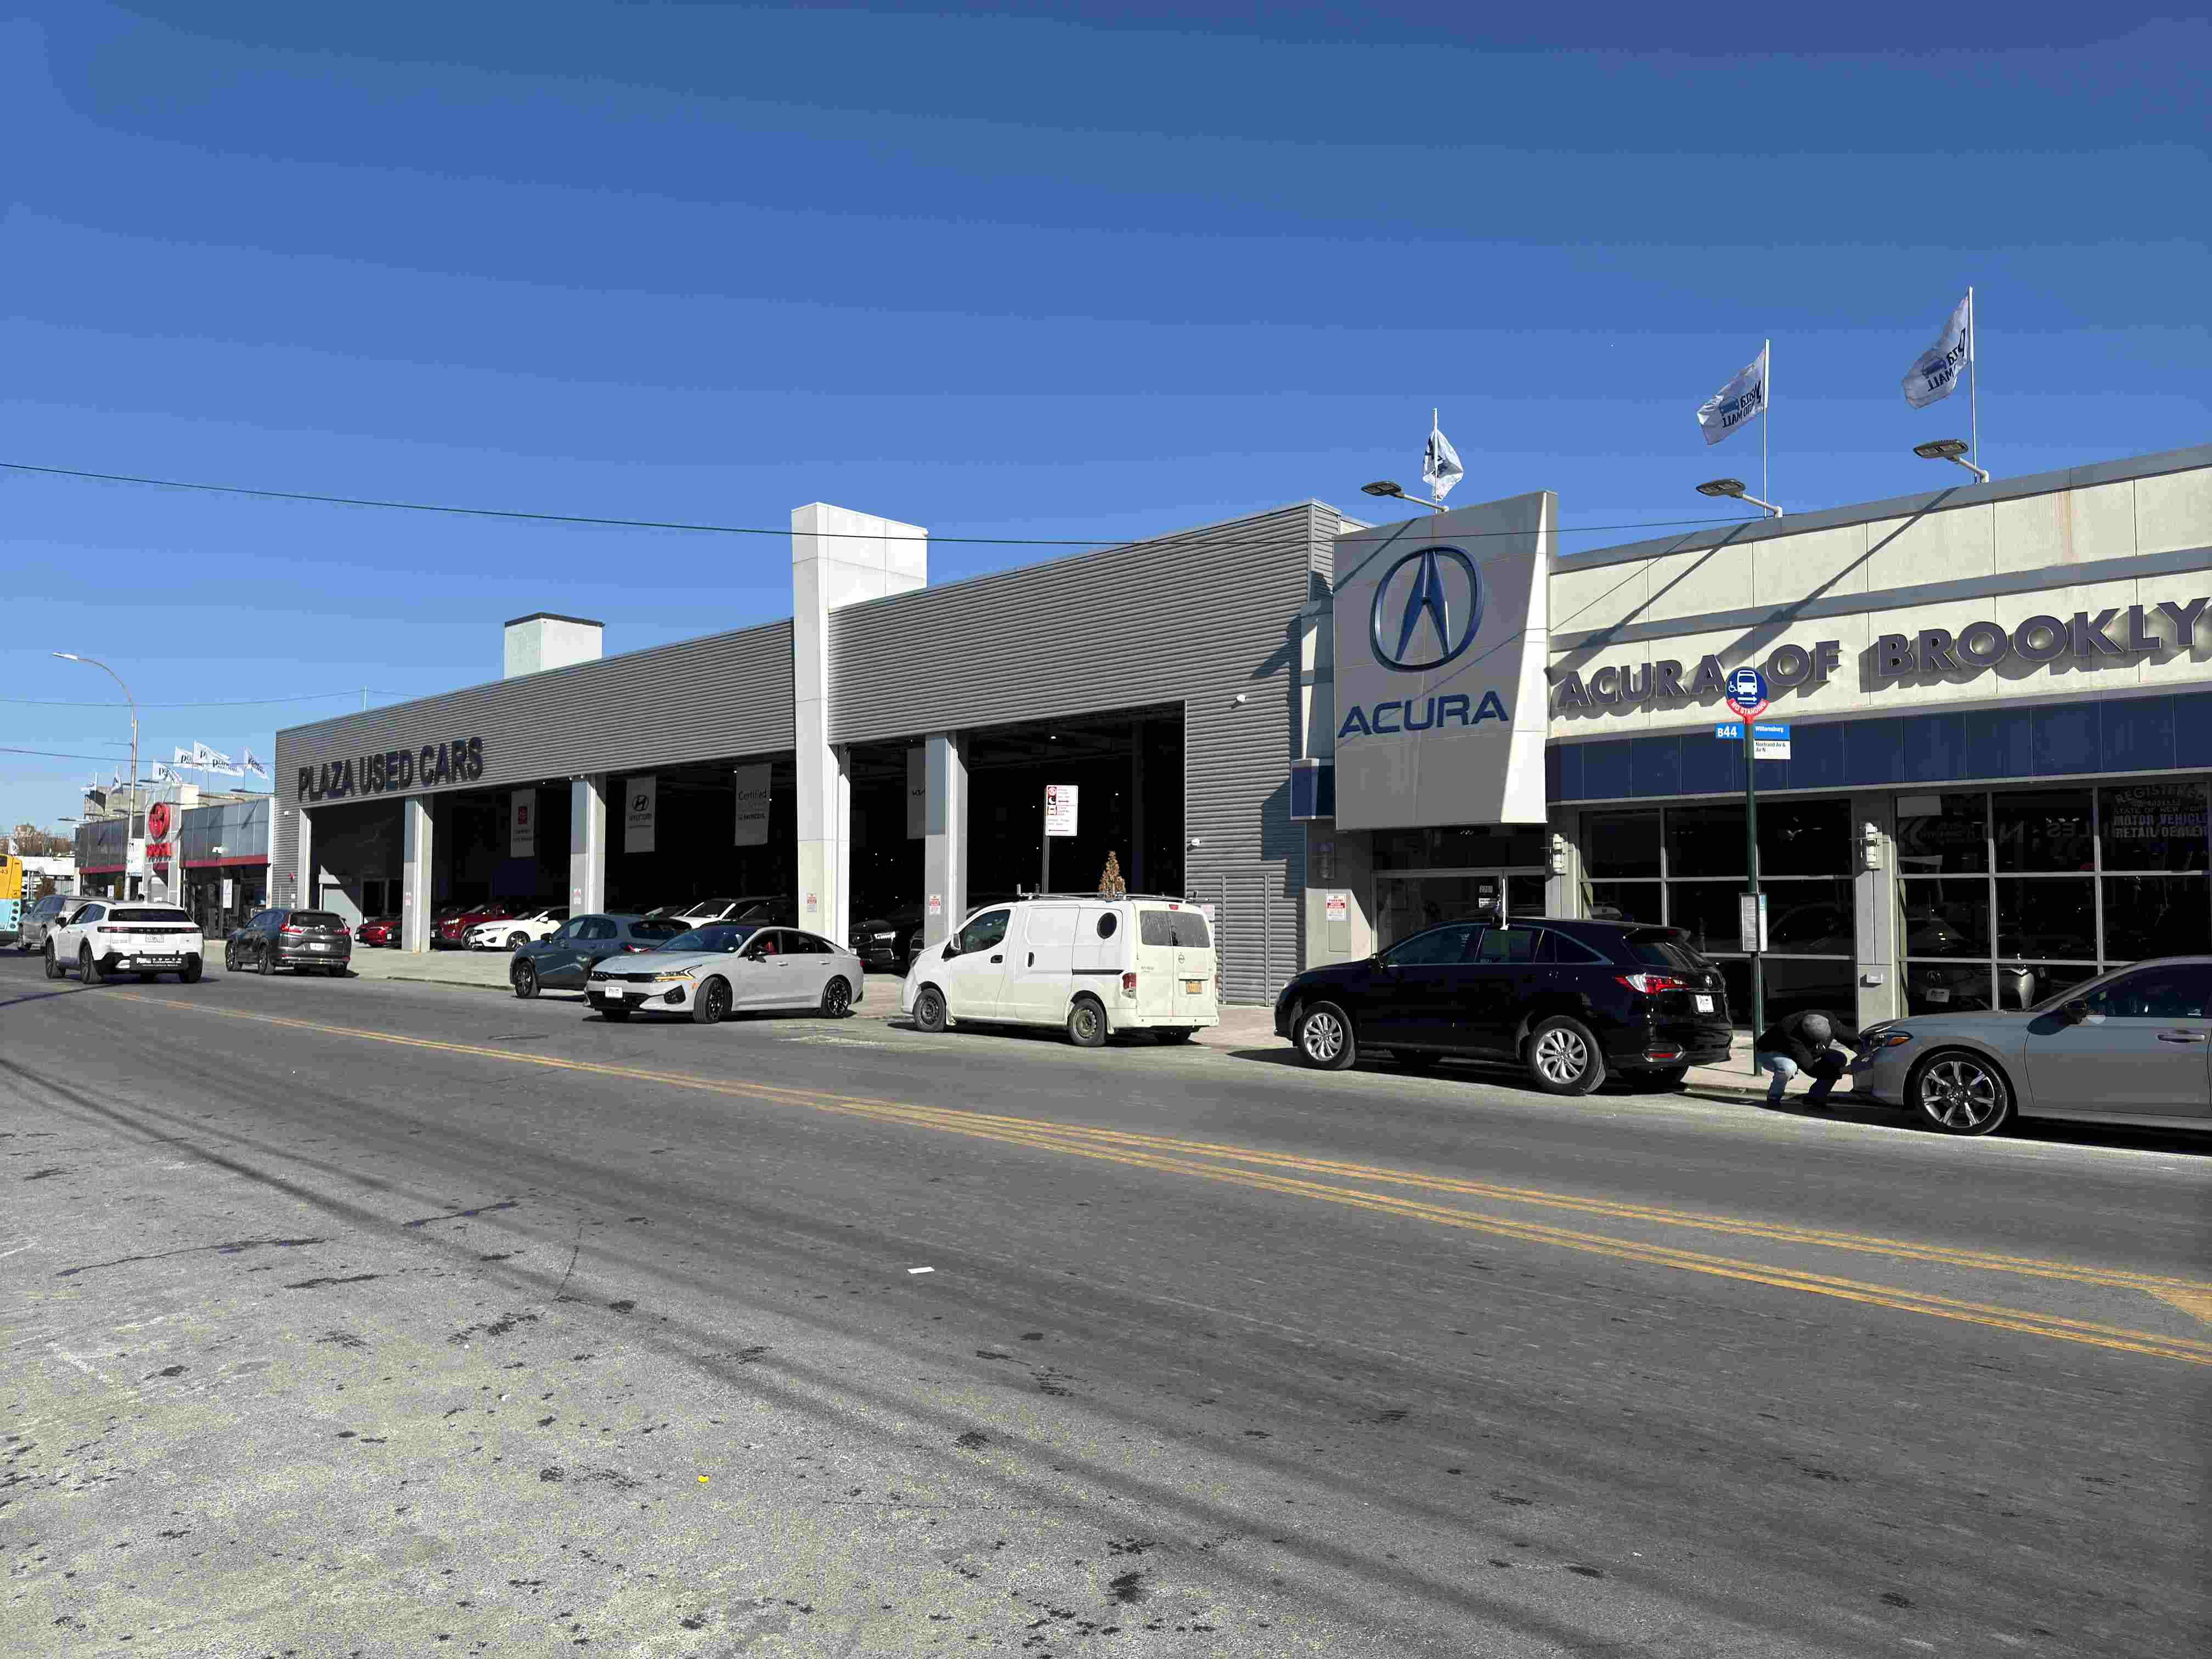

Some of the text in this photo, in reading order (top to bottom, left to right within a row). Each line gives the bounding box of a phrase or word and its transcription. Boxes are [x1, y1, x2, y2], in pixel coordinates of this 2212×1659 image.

[1557, 596, 2211, 708] ACURA OF BROOKLY
[1338, 690, 1510, 738] ACURA
[1731, 701, 1767, 716] NO STANDING
[1718, 725, 1737, 737] B44
[298, 759, 356, 802] PLAZA
[359, 749, 413, 795] USED
[420, 736, 483, 786] CARS
[2113, 814, 2155, 826] MOTOR
